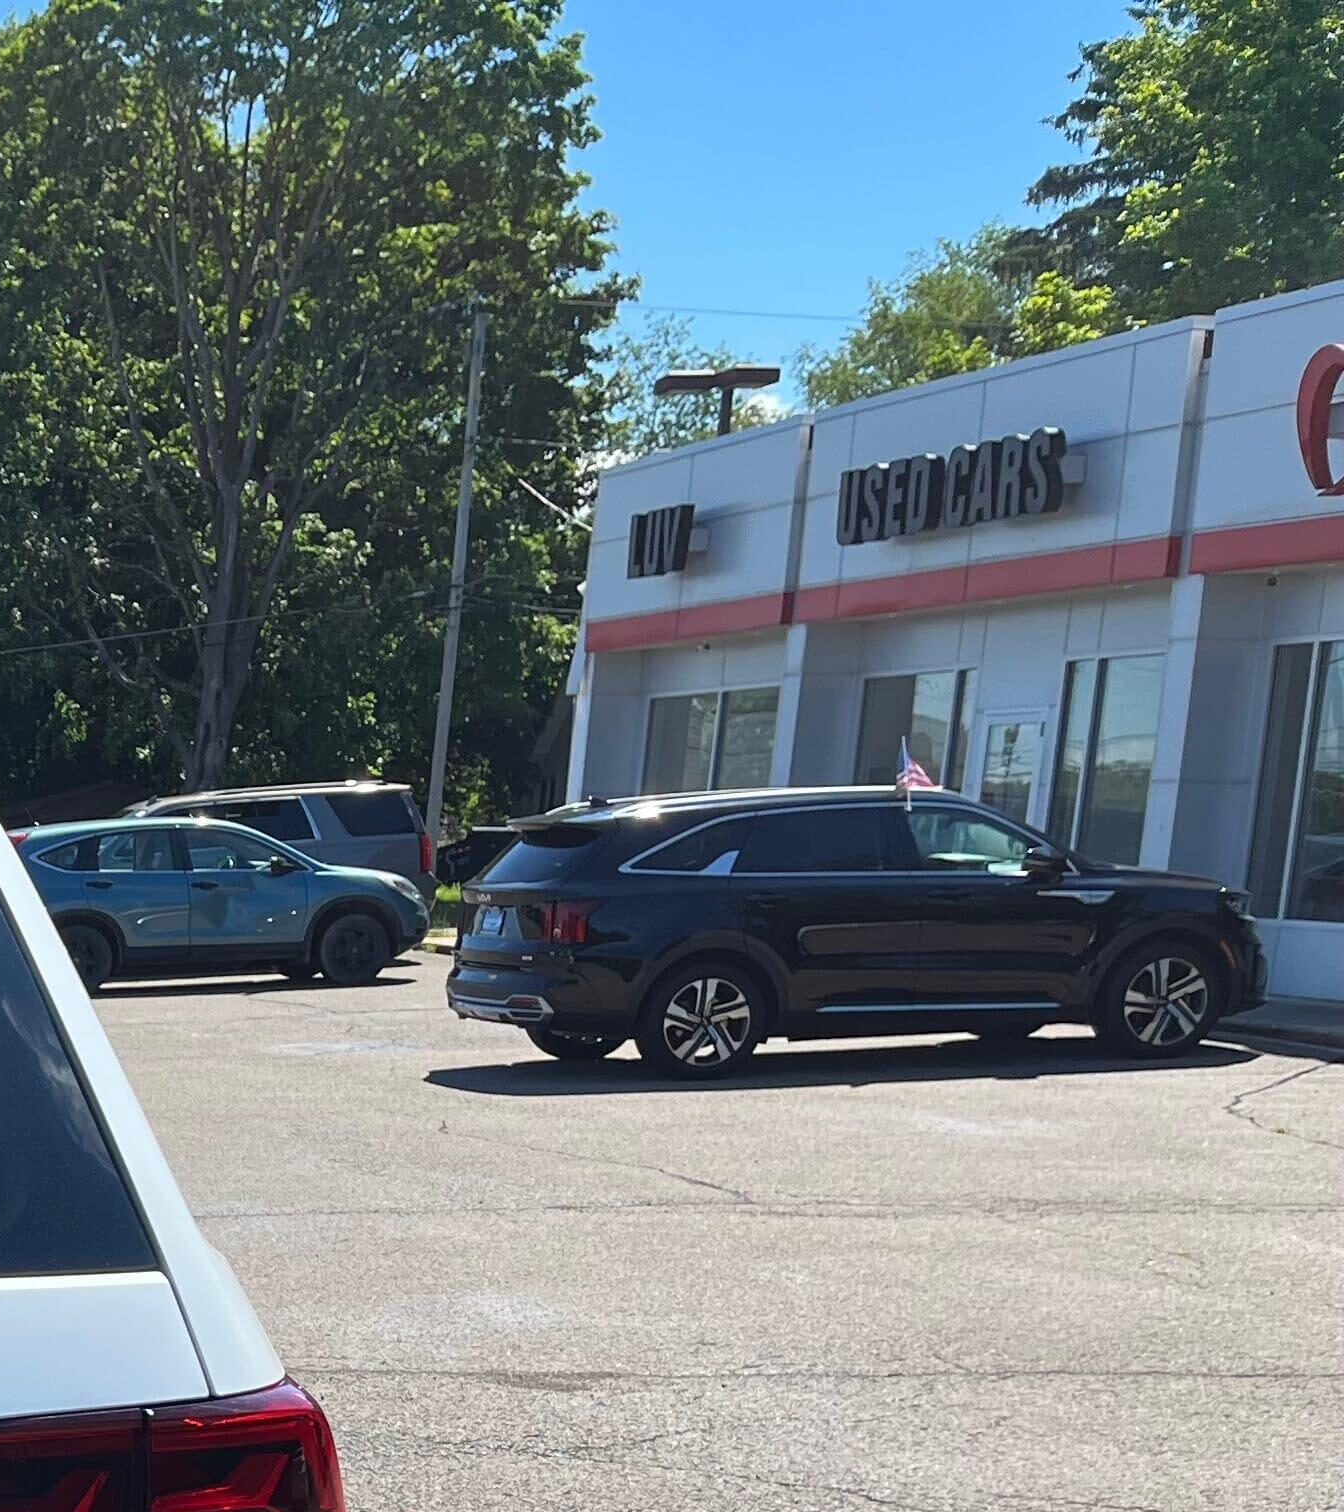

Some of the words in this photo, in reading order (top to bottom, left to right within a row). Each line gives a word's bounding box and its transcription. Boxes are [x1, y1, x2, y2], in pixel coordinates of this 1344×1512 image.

[837, 453, 944, 545] USED
[945, 426, 1067, 528] CARS
[627, 504, 695, 579] LUV
